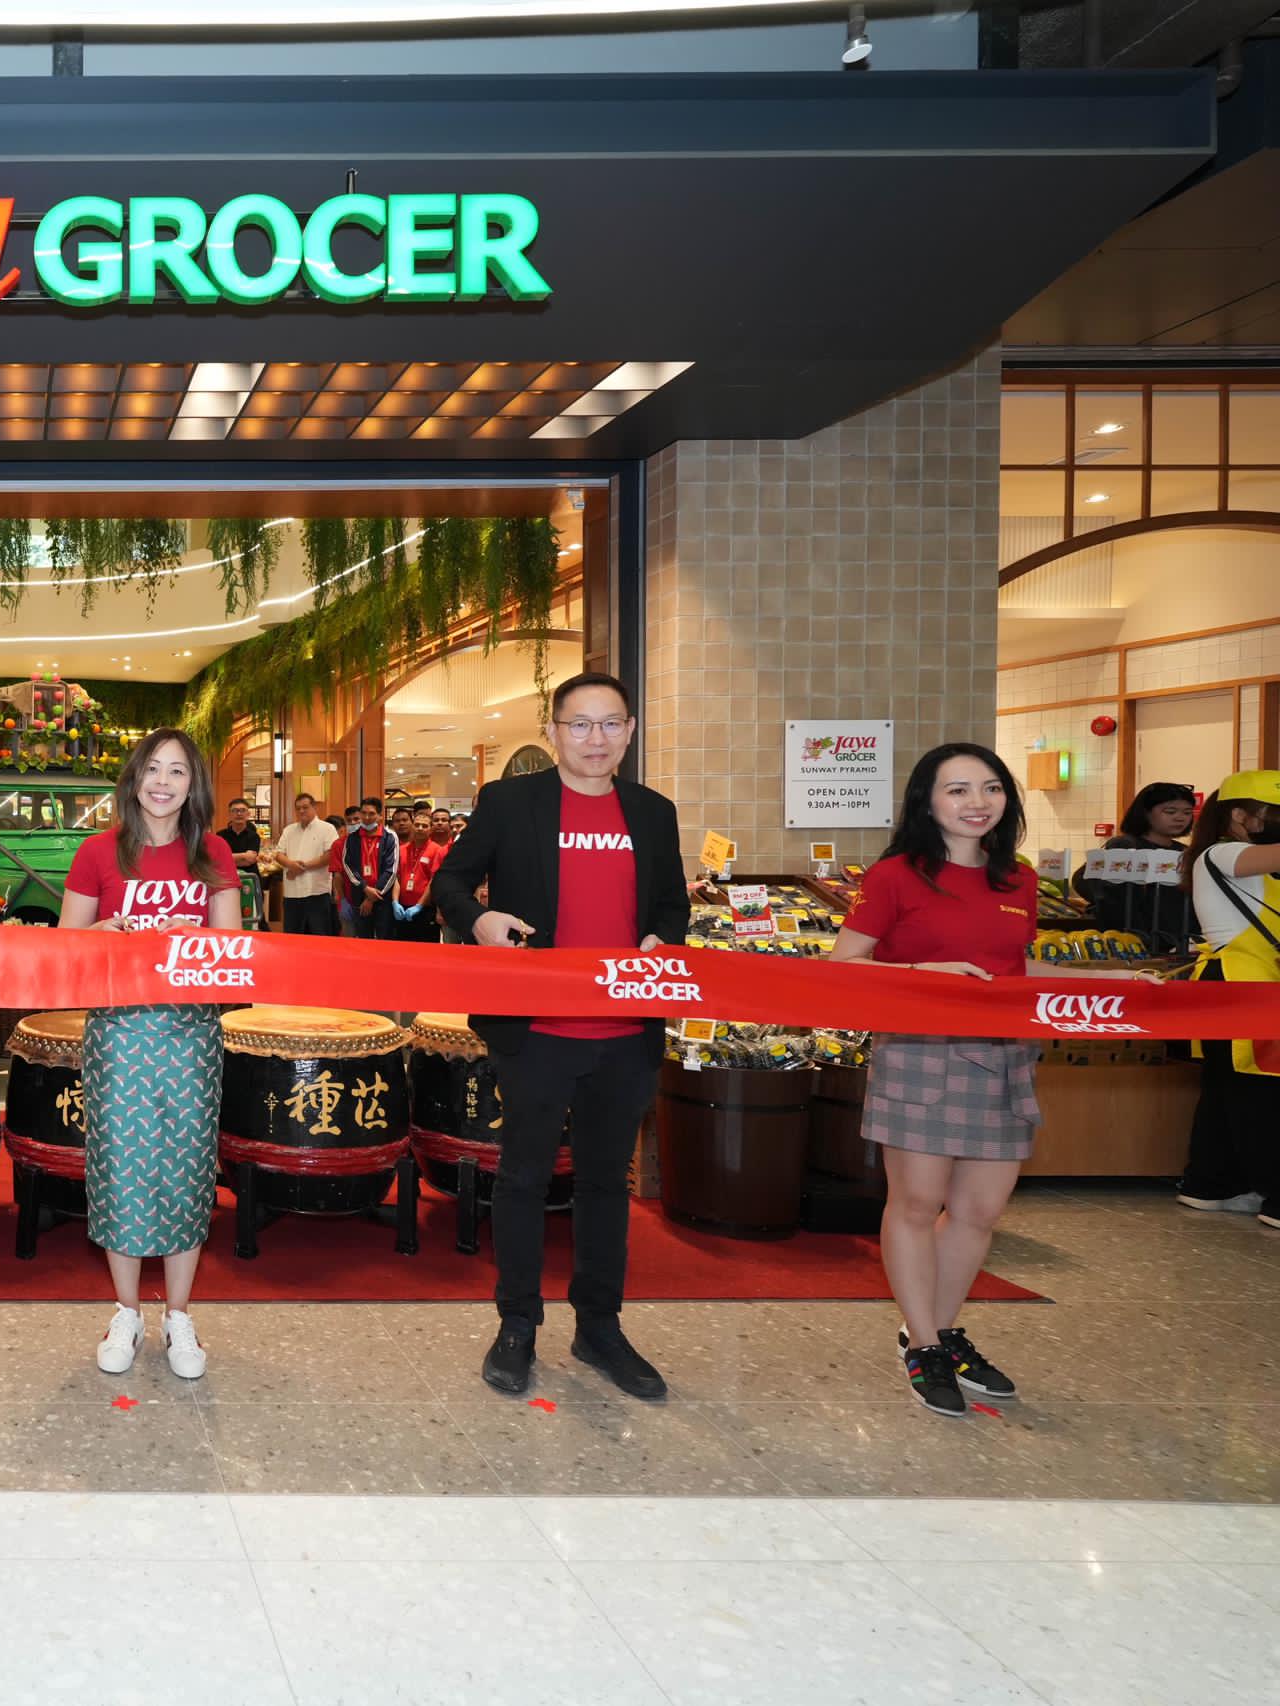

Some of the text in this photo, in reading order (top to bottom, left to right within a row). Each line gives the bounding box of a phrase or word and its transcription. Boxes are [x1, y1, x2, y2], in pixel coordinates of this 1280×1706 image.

[33, 193, 553, 306] GROCER
[829, 736, 877, 754] Jaya
[835, 752, 876, 761] GROCER
[808, 788, 870, 796] OPEN DAILY
[113, 879, 208, 919] Jaya
[154, 935, 255, 973] Jaya
[168, 968, 255, 986] GROCER
[594, 956, 693, 985] Jaya
[607, 981, 703, 1001] GROCER
[1029, 992, 1125, 1024] Jaya
